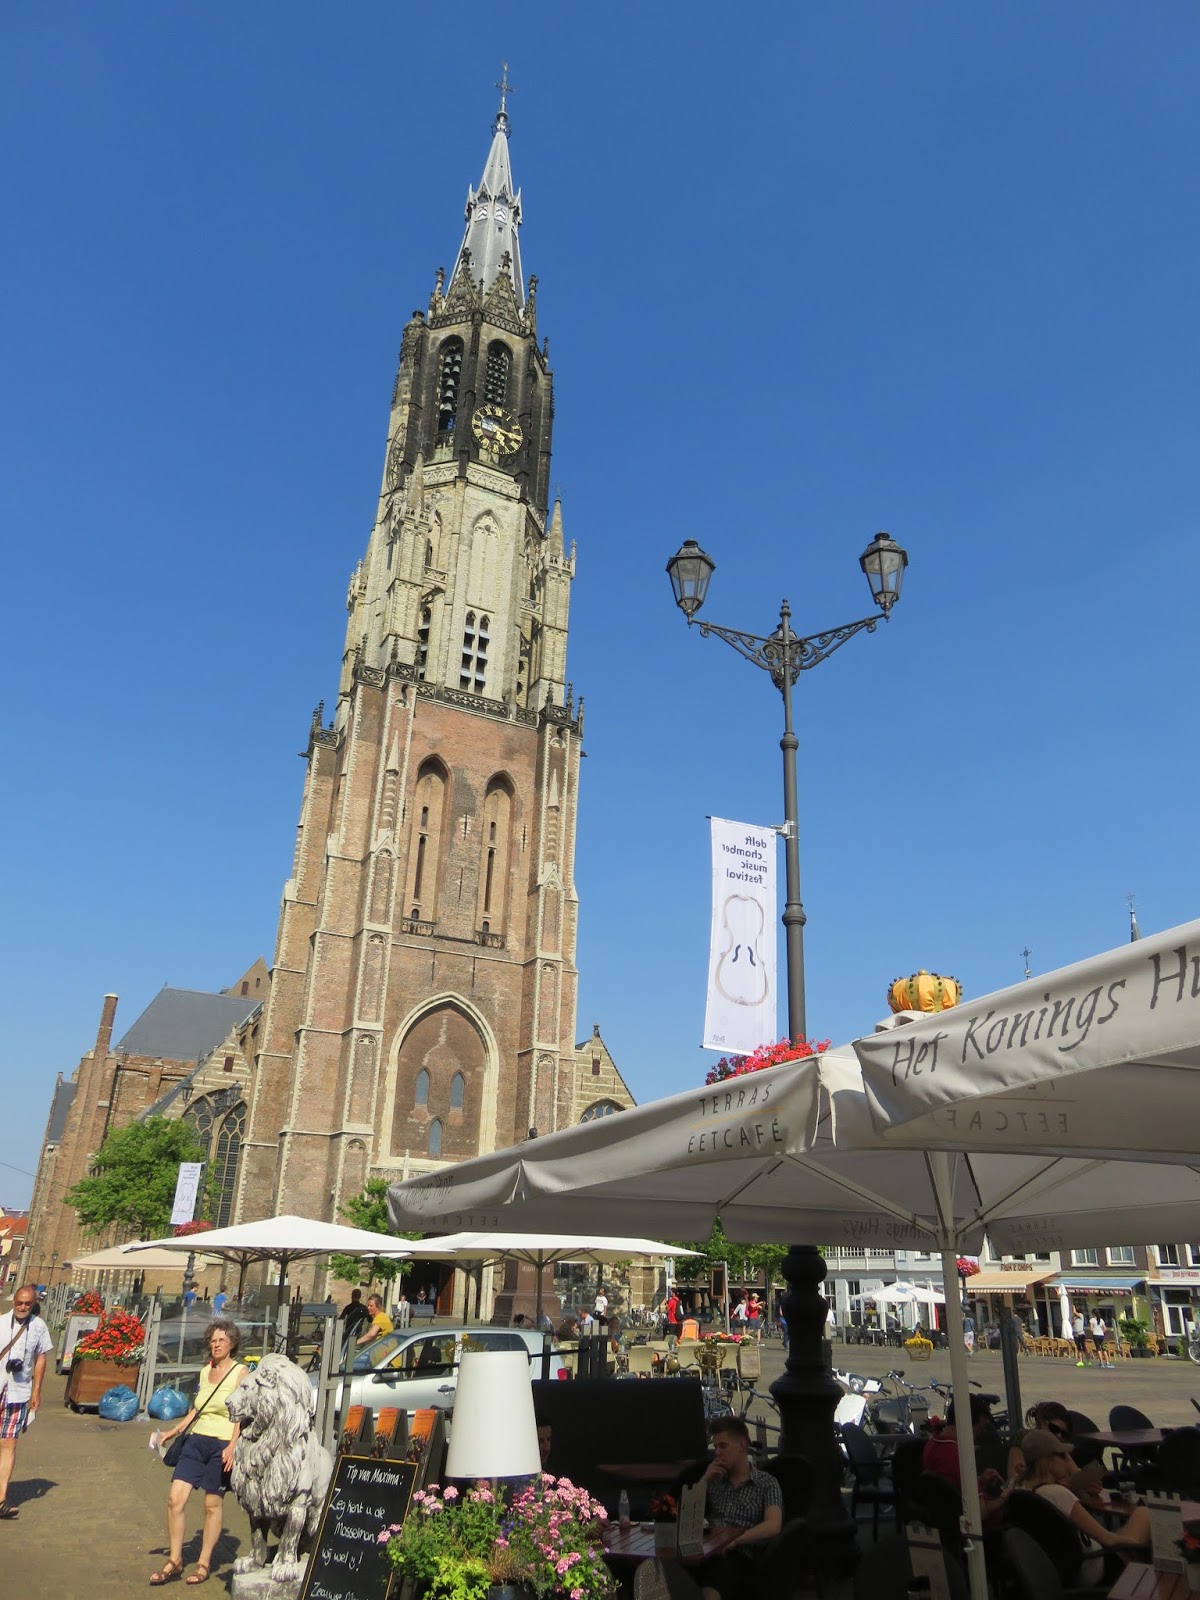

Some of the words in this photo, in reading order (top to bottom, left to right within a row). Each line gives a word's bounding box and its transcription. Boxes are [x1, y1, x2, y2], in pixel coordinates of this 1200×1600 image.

[892, 1031, 948, 1087] Het
[961, 978, 1127, 1064] Konings
[699, 1083, 773, 1116] TERRAS
[687, 1117, 783, 1154] EETCAFÉ
[346, 1464, 358, 1484] Tip
[358, 1469, 371, 1482] van
[329, 1487, 346, 1520] Zeg
